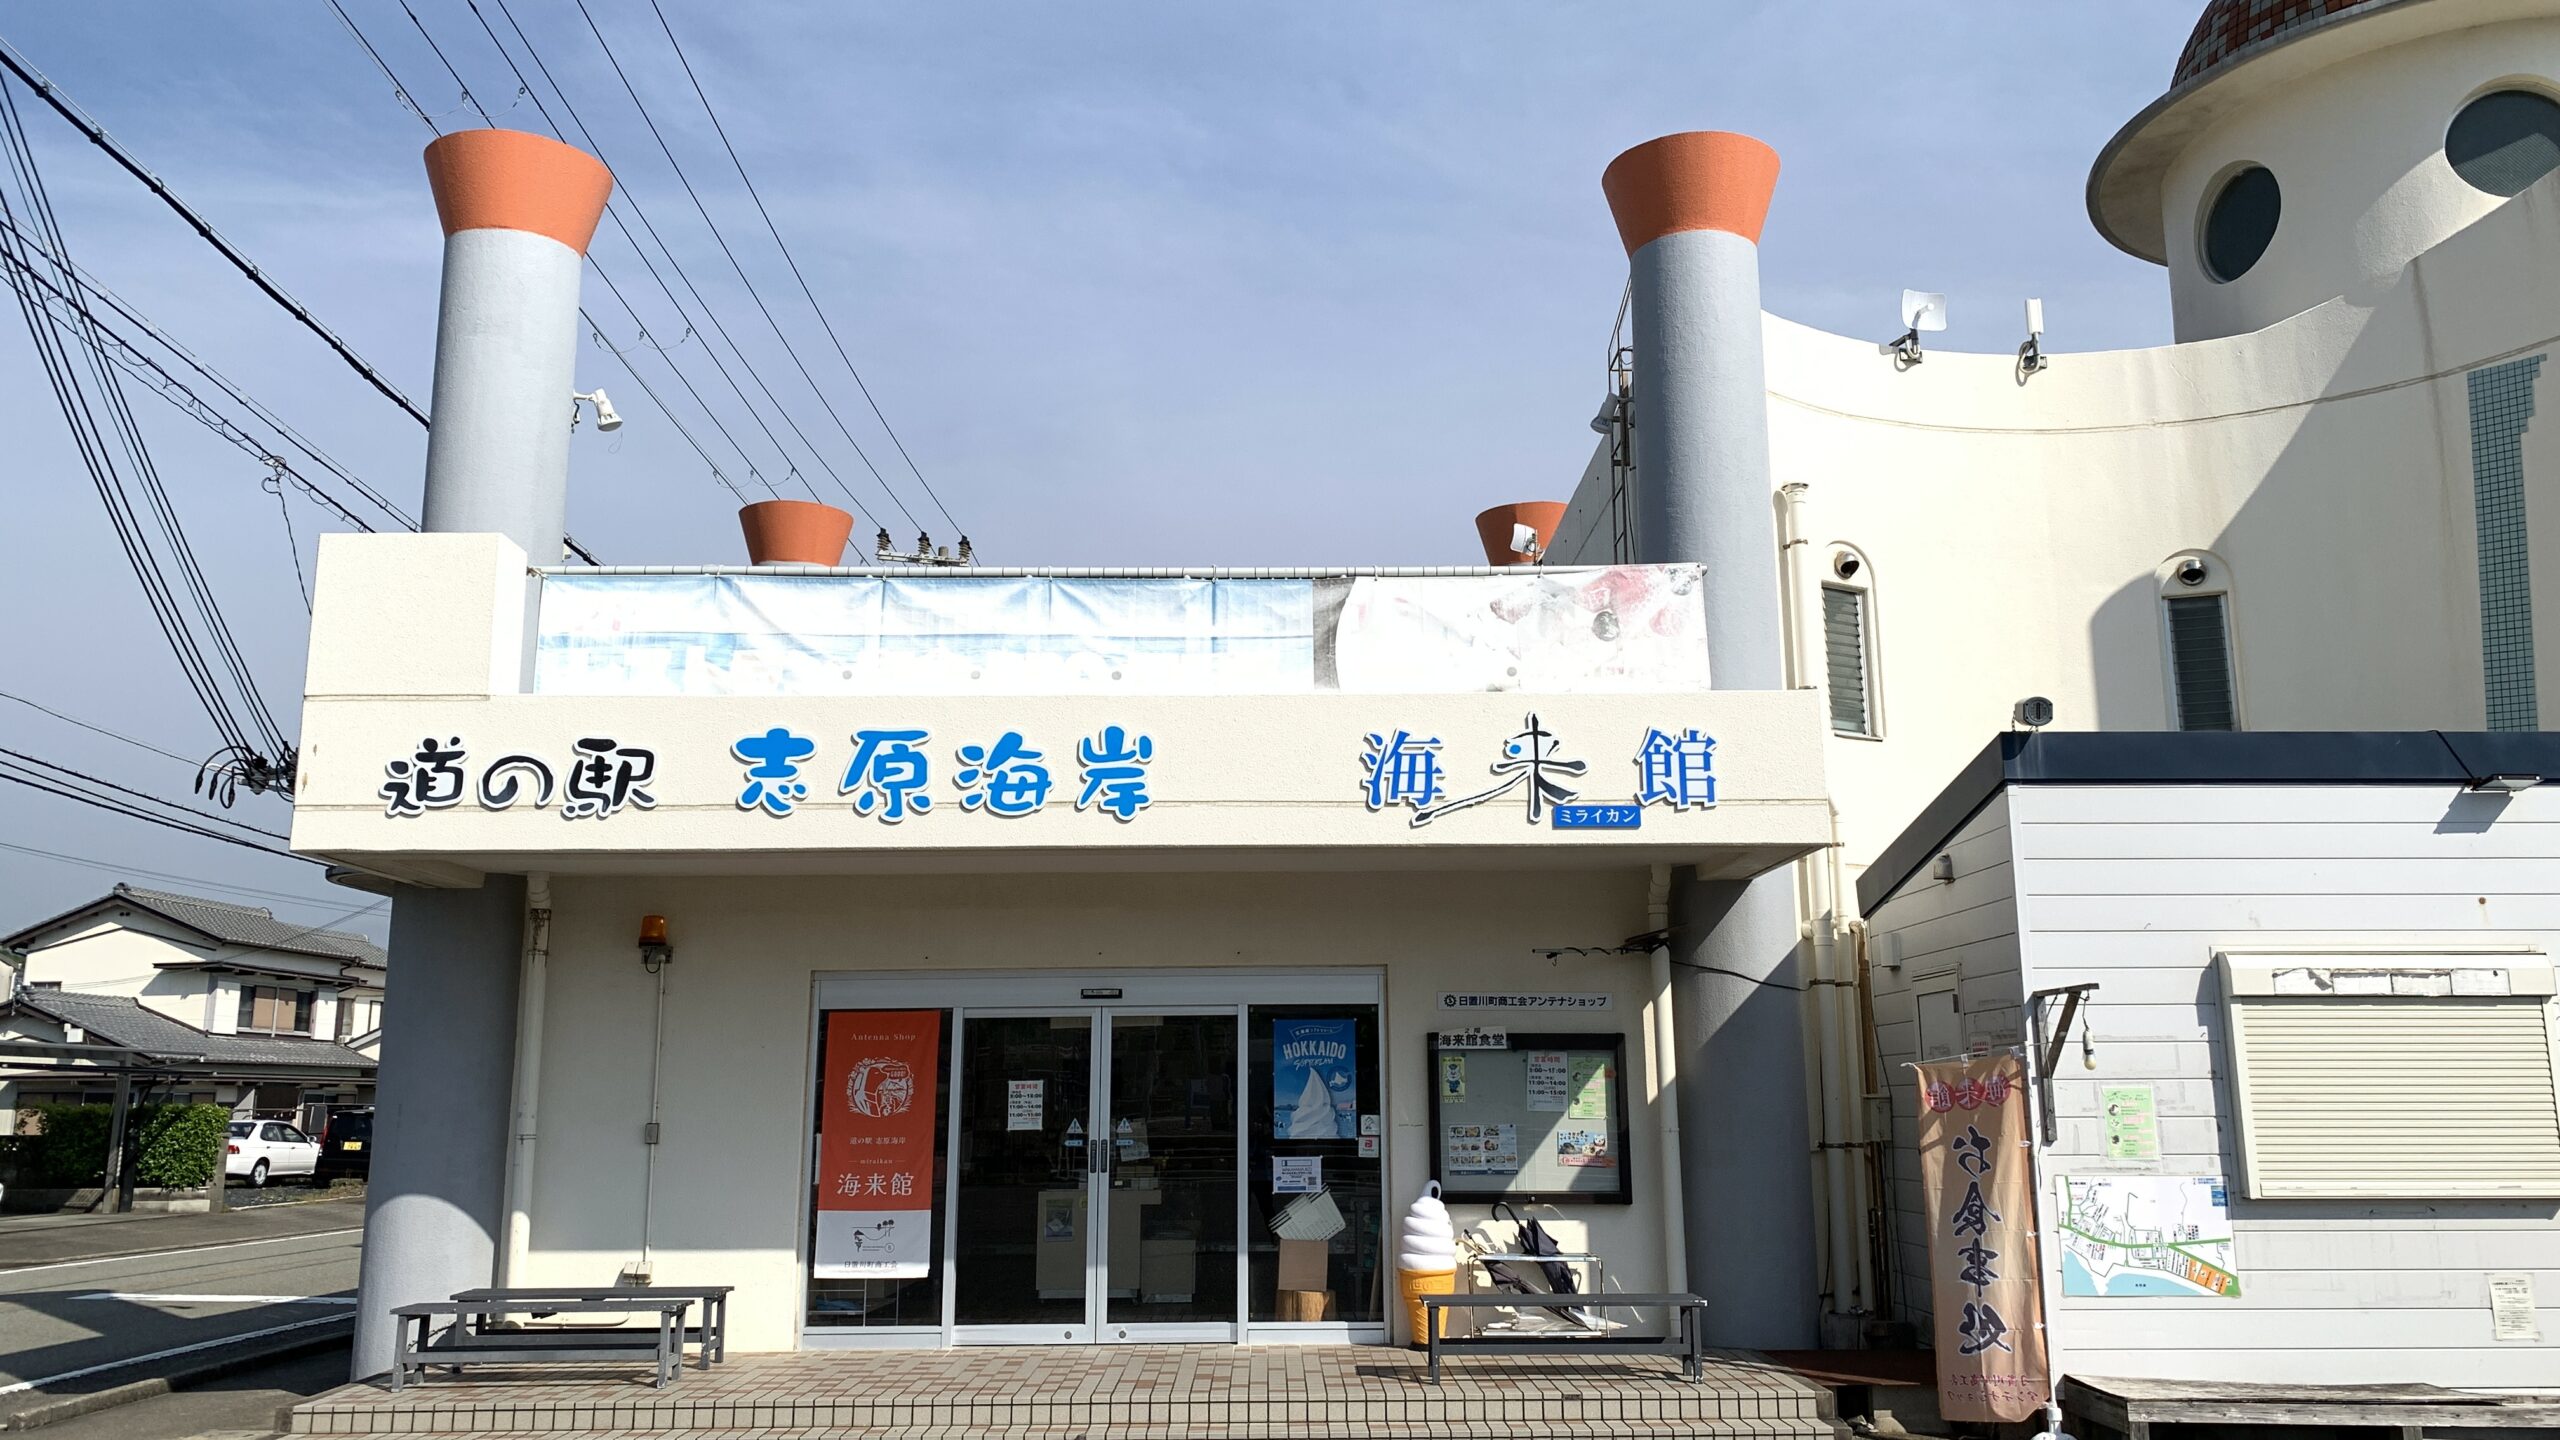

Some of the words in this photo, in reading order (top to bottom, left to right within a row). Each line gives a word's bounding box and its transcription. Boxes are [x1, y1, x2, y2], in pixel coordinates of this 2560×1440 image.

[382, 735, 656, 816] 道の駅
[733, 724, 1154, 820] 志原海岸
[1364, 712, 1717, 823] 海来館
[1560, 808, 1637, 824] ミライカン
[1458, 995, 1607, 1007] 日置川町商工会アンテナショップ
[851, 1033, 890, 1041] Antenna
[893, 1033, 916, 1042] Shop
[1439, 1034, 1505, 1047] 海来館食堂
[1283, 1041, 1347, 1060] HOKKAIDO
[837, 1172, 914, 1197] 海来館
